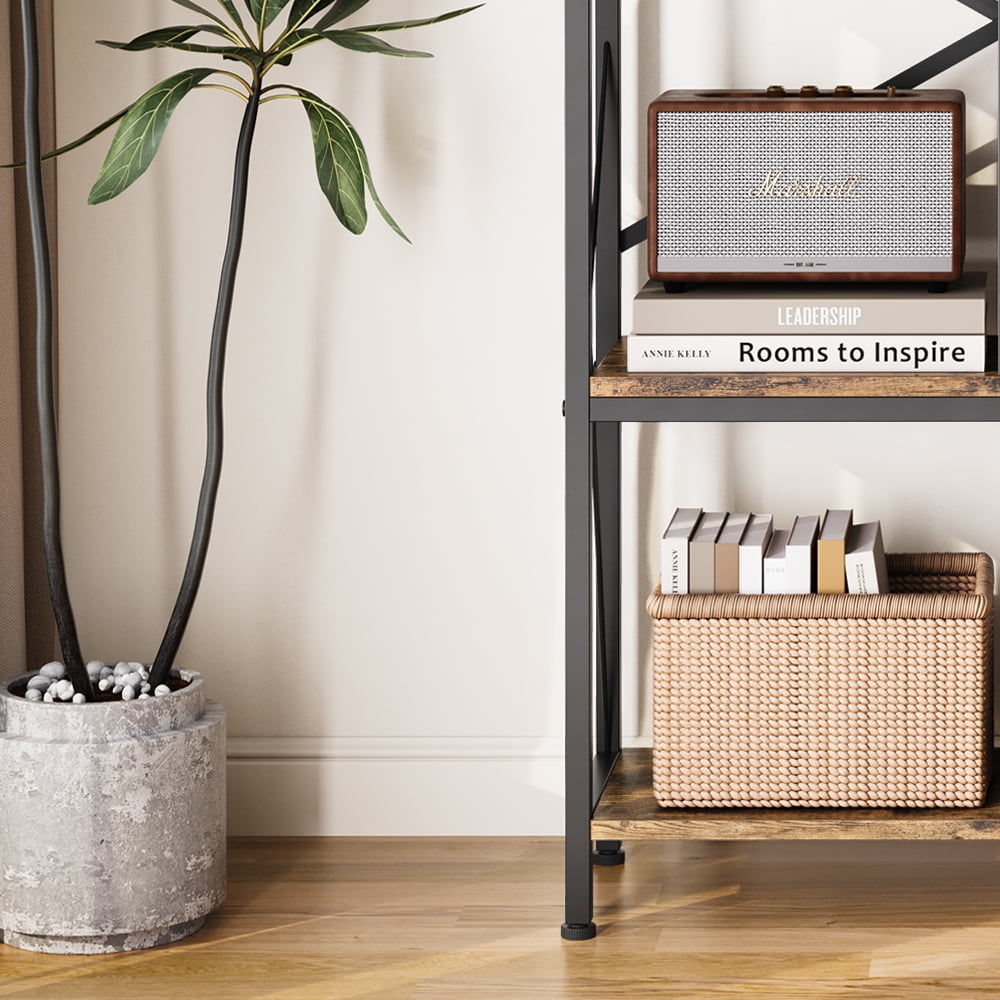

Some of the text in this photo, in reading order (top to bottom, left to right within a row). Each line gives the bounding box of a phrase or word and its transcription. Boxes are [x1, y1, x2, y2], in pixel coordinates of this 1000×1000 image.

[747, 168, 862, 199] Marshall
[777, 306, 862, 327] LEADERSHIP
[641, 341, 967, 369] ANNIE KELLY Rooms to Inspire
